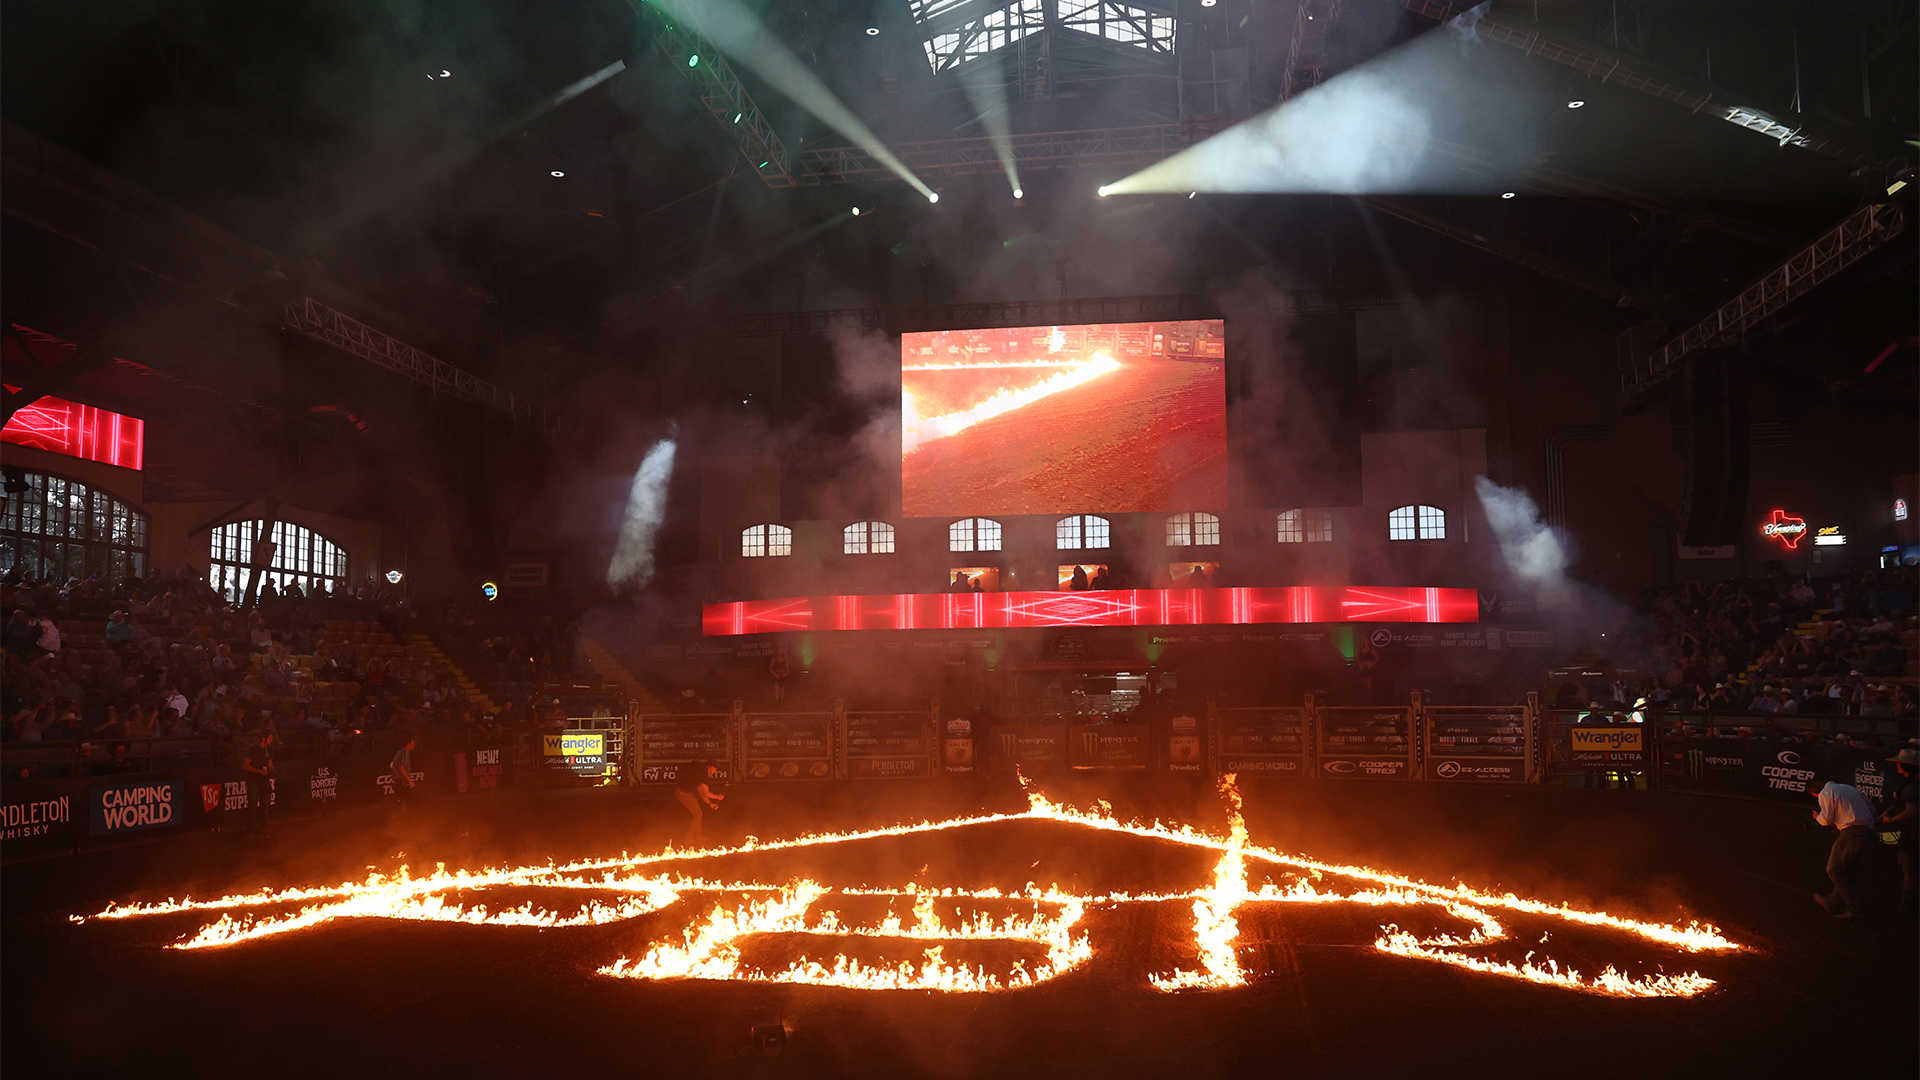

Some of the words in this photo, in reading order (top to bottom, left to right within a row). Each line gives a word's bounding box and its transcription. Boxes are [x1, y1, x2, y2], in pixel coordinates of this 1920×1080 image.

[546, 737, 600, 753] Wrangler
[1575, 731, 1640, 748] Wrangler
[476, 749, 499, 765] NEW!
[575, 756, 602, 764] ULTRA
[1761, 766, 1815, 781] COOPER
[1768, 778, 1807, 792] TIRES
[102, 784, 173, 808] CAMPING
[103, 802, 173, 831] WORLD
